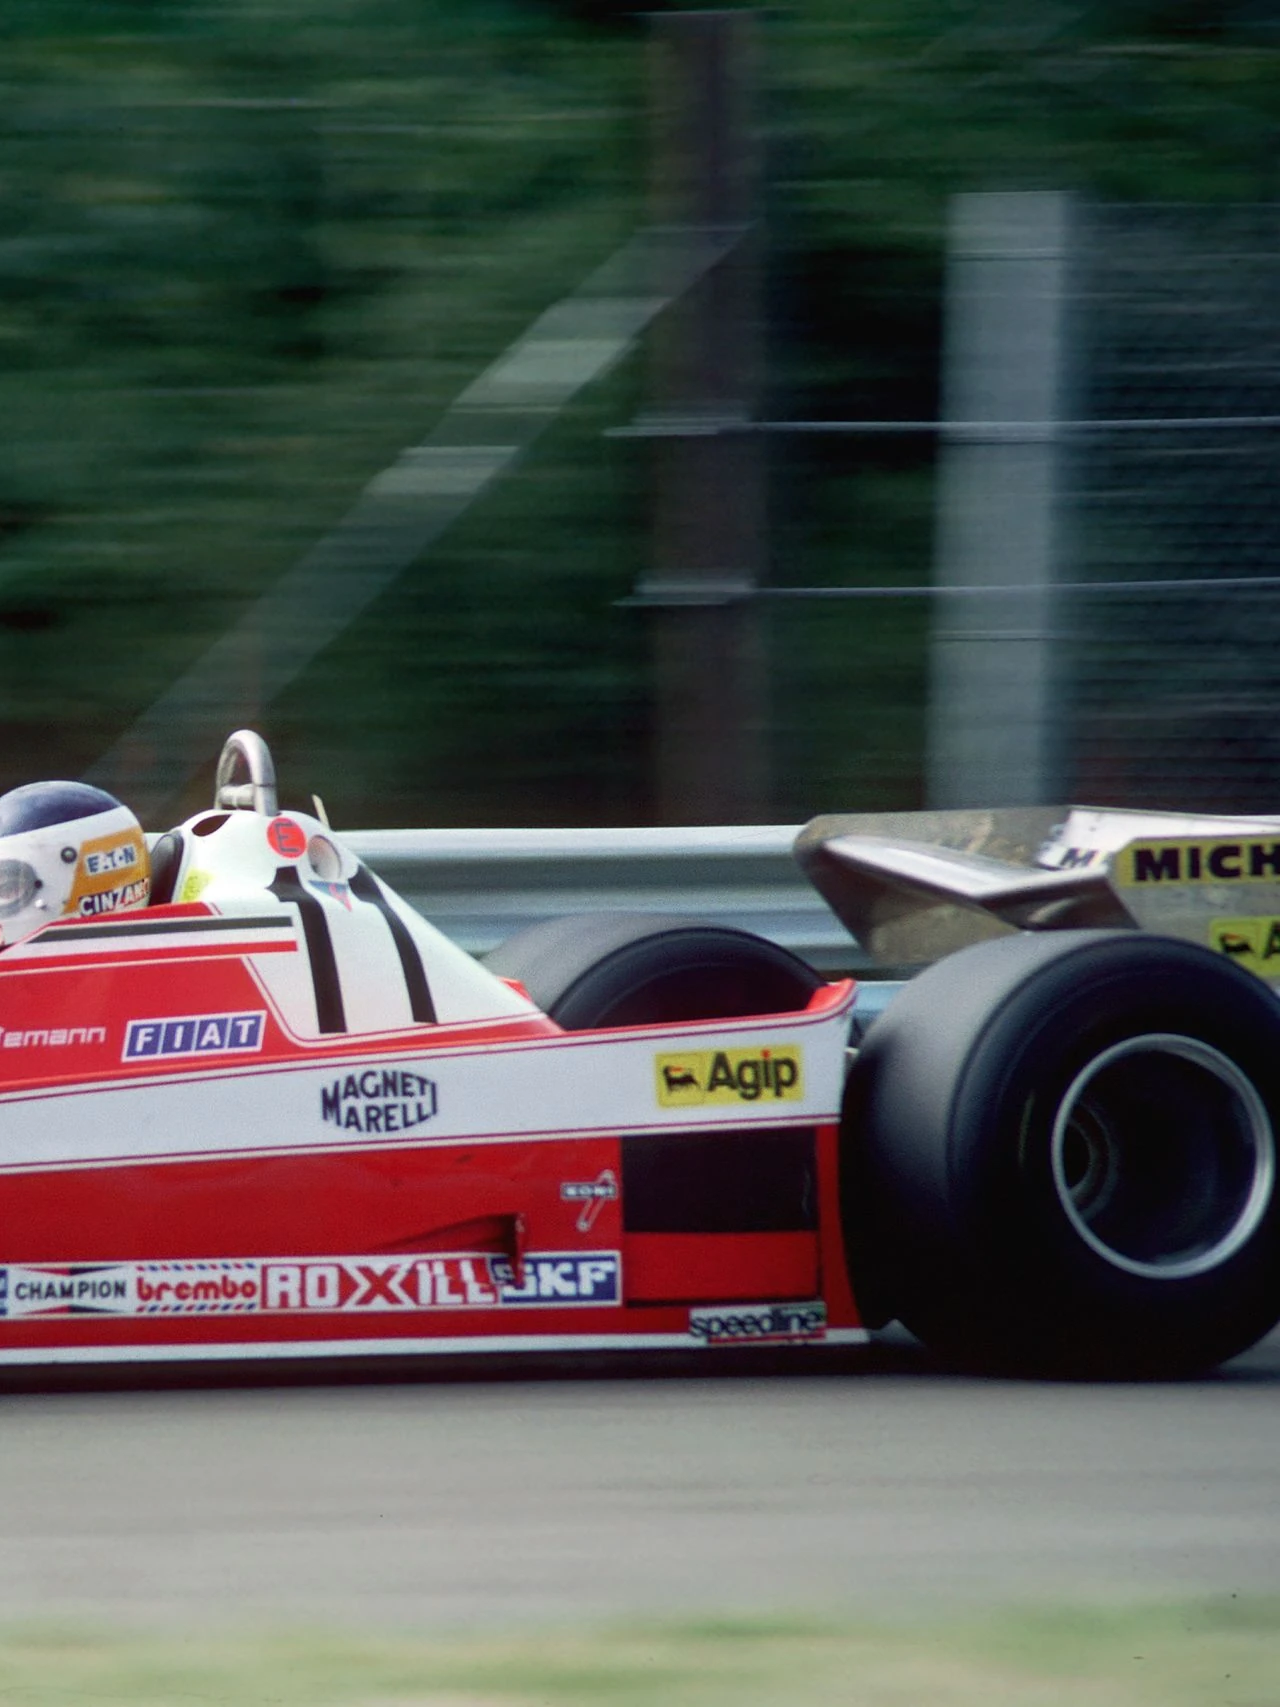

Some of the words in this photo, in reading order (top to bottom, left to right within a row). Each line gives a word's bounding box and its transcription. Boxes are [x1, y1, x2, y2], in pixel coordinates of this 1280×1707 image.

[135, 1018, 256, 1053] FIAT
[322, 1070, 437, 1118] MAGNETI
[708, 1050, 799, 1100] Agip
[322, 1087, 438, 1133] MARELLI
[15, 1279, 126, 1300] CHAMPION
[136, 1275, 257, 1301] brembo
